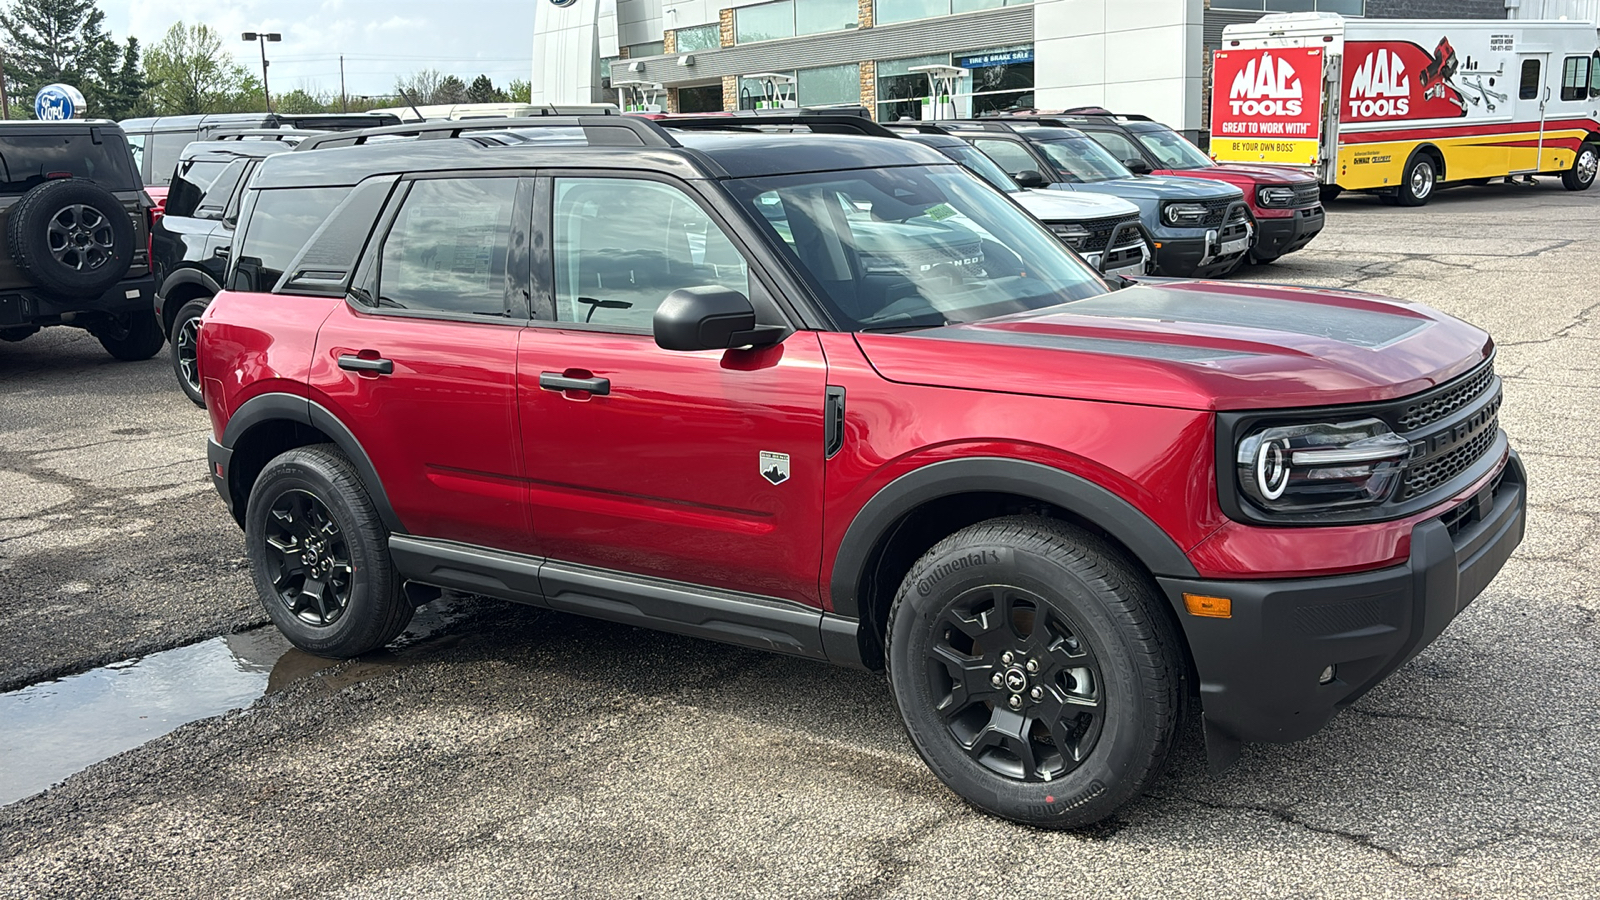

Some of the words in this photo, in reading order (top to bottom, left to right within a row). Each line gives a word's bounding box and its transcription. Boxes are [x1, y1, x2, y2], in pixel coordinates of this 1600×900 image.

[969, 57, 983, 65] TIRE
[990, 53, 1011, 62] BRAKE
[1012, 51, 1029, 60] SALE
[1229, 54, 1303, 99] MAC
[1349, 48, 1410, 98] MAC
[41, 94, 65, 120] Ford
[1229, 99, 1303, 116] TOOLS
[1349, 98, 1410, 118] TOOLS
[1222, 121, 1247, 133] GREAT
[1248, 121, 1258, 134] TO
[1260, 122, 1284, 134] WORK
[1232, 142, 1240, 151] BE
[1242, 142, 1259, 152] YOUR
[1260, 143, 1275, 152] OWN
[920, 257, 979, 272] BNCO
[916, 550, 988, 598] Continental
